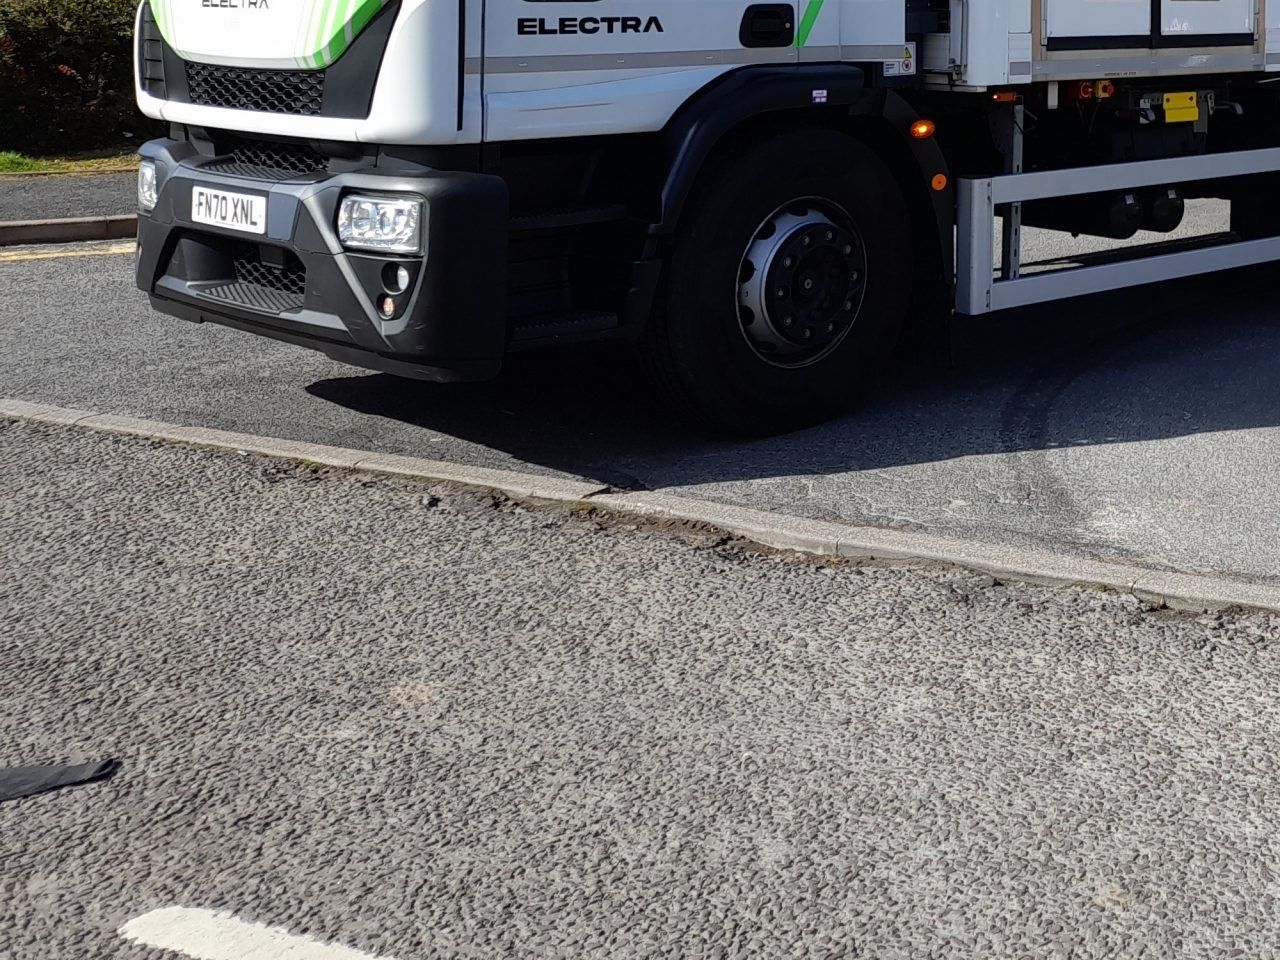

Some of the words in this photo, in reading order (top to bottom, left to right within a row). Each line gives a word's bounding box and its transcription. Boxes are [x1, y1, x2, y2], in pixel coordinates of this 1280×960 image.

[517, 16, 664, 35] ELECTRA
[197, 191, 227, 220] FN70
[232, 197, 257, 226] XNL
